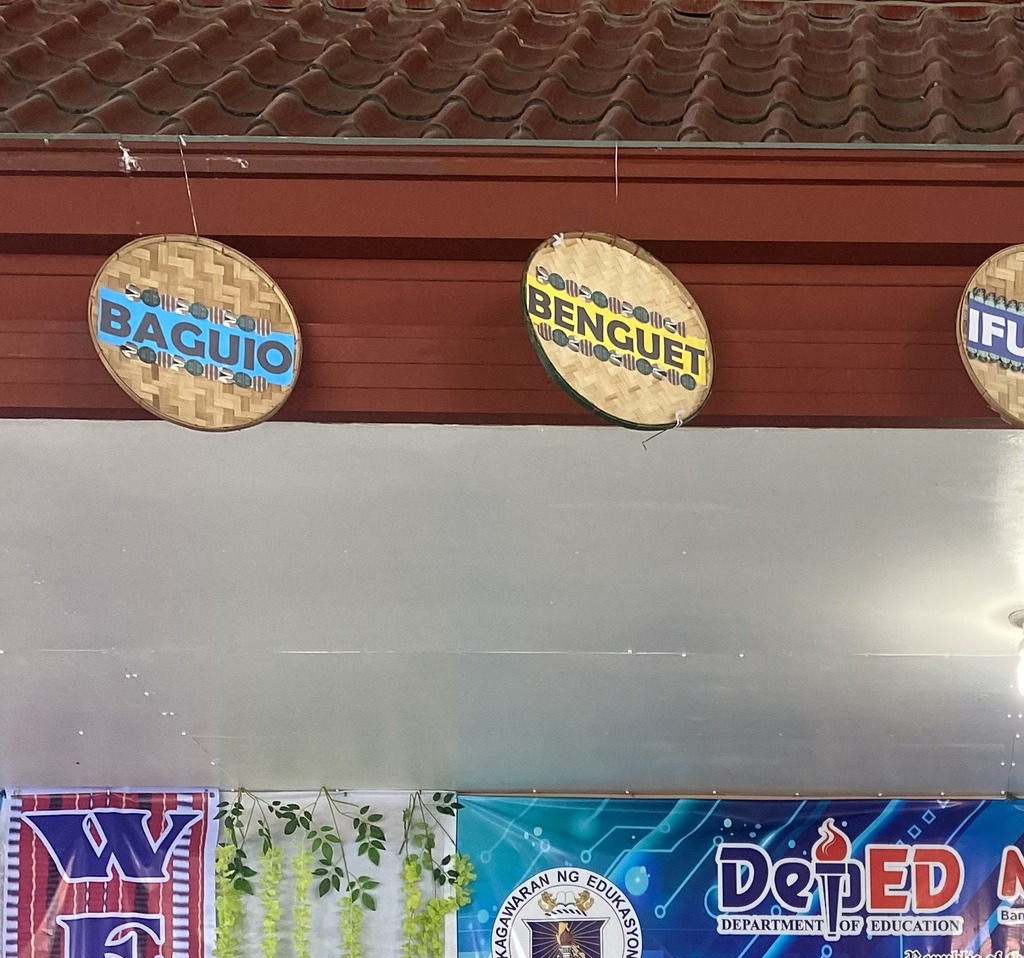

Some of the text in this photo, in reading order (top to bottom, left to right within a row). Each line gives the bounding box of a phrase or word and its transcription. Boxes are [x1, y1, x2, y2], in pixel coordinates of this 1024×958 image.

[101, 297, 293, 375] BAGUIO
[527, 287, 705, 376] BENGUET
[557, 870, 579, 883] NG
[721, 919, 960, 932] DEPARTMENT OF EDUCATION
